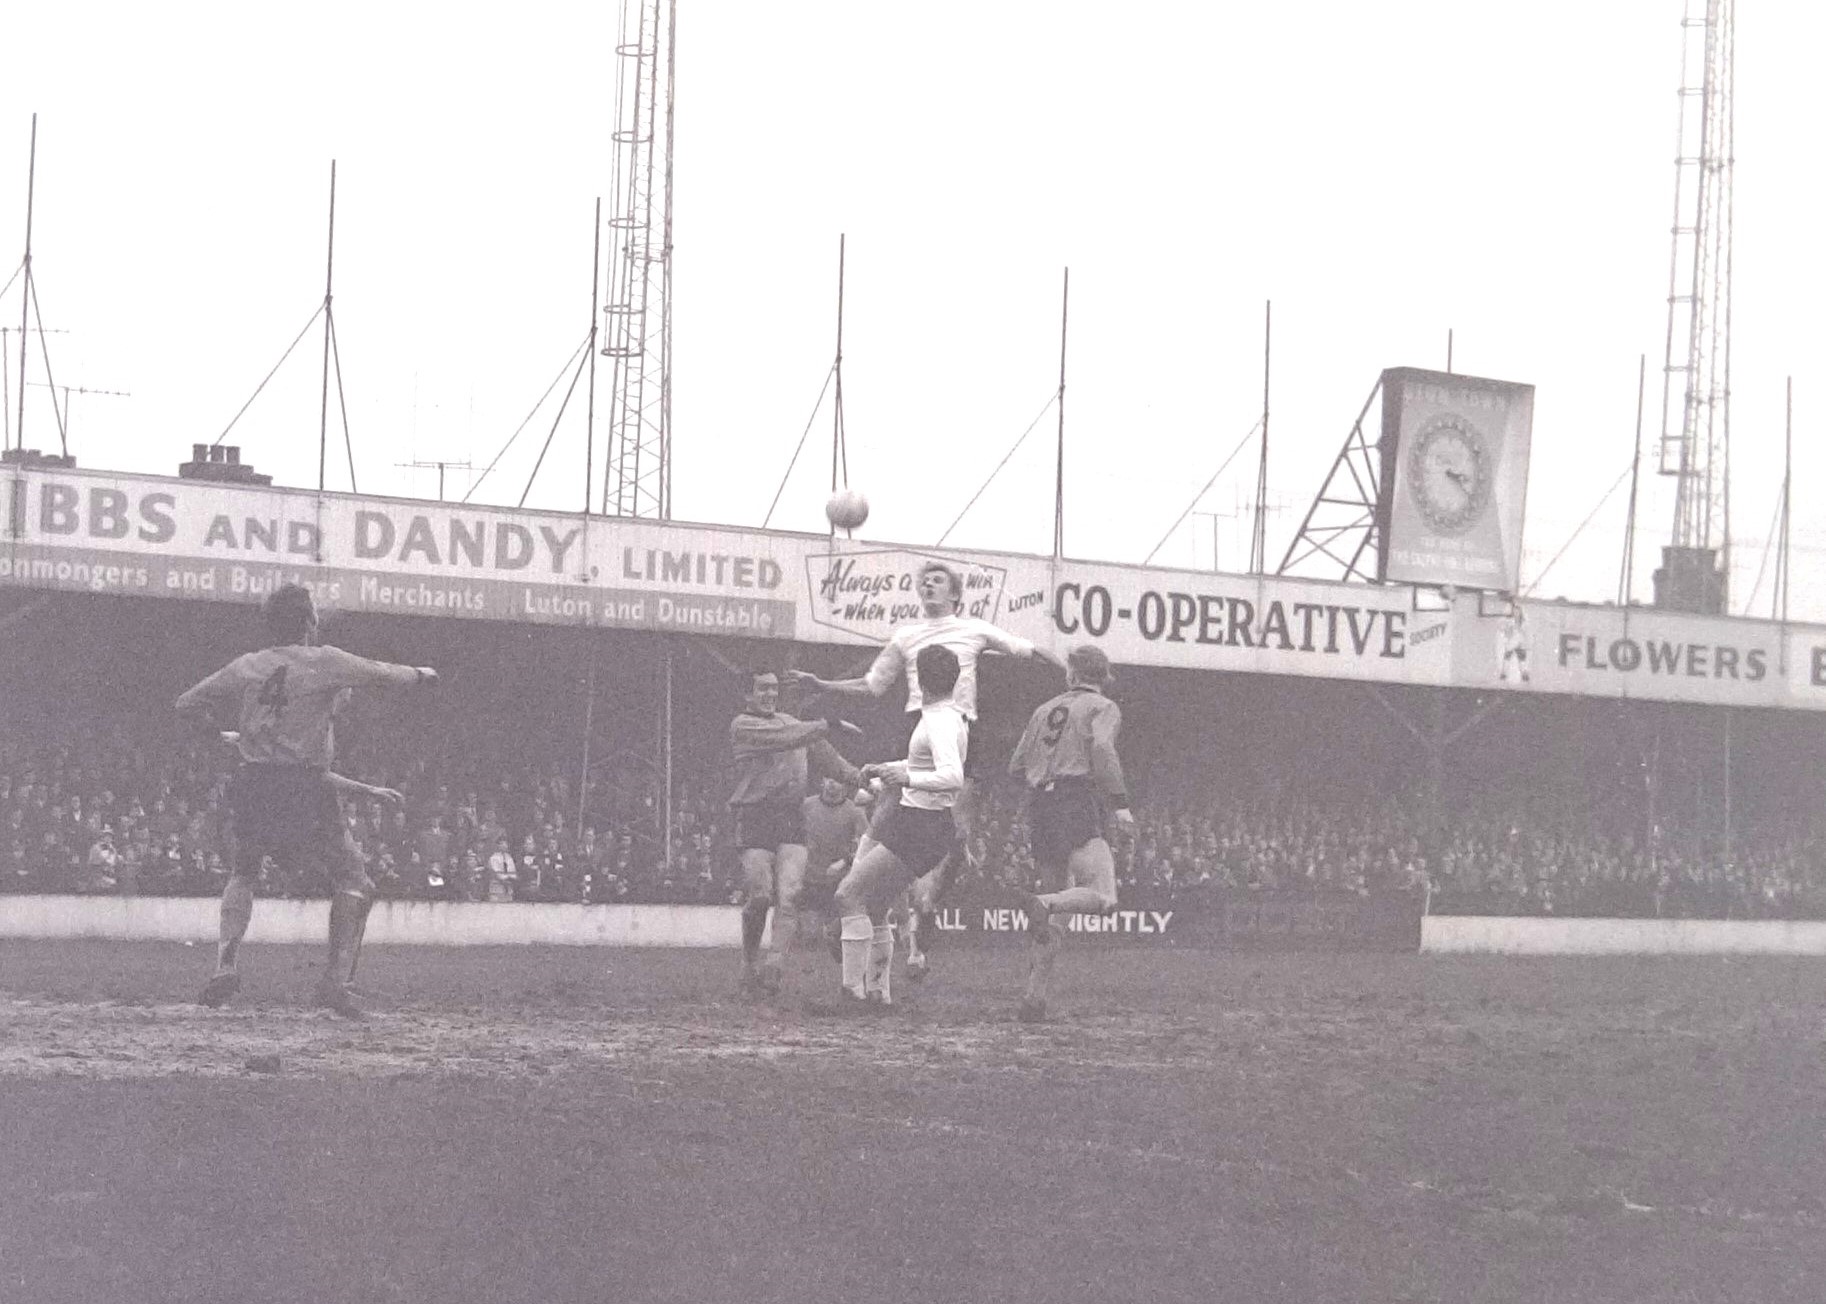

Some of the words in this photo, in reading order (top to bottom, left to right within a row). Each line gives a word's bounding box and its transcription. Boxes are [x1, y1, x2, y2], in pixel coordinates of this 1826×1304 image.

[203, 513, 319, 556] AND
[622, 546, 782, 590] LIMITED
[166, 565, 215, 591] and
[360, 577, 486, 612] Merchants
[524, 588, 591, 619] Luton
[604, 596, 645, 622] and
[658, 598, 772, 631] Dunstable
[820, 559, 895, 603] Always
[899, 573, 912, 591] a
[1008, 590, 1044, 613] LUTON
[890, 604, 919, 624] you
[970, 594, 990, 619] at
[1053, 581, 1407, 659] CO-OPERATIVE
[1410, 622, 1448, 646] SOCIETY
[1557, 632, 1766, 682] FLOWERS
[258, 664, 288, 718] 4
[1043, 706, 1069, 747] 9
